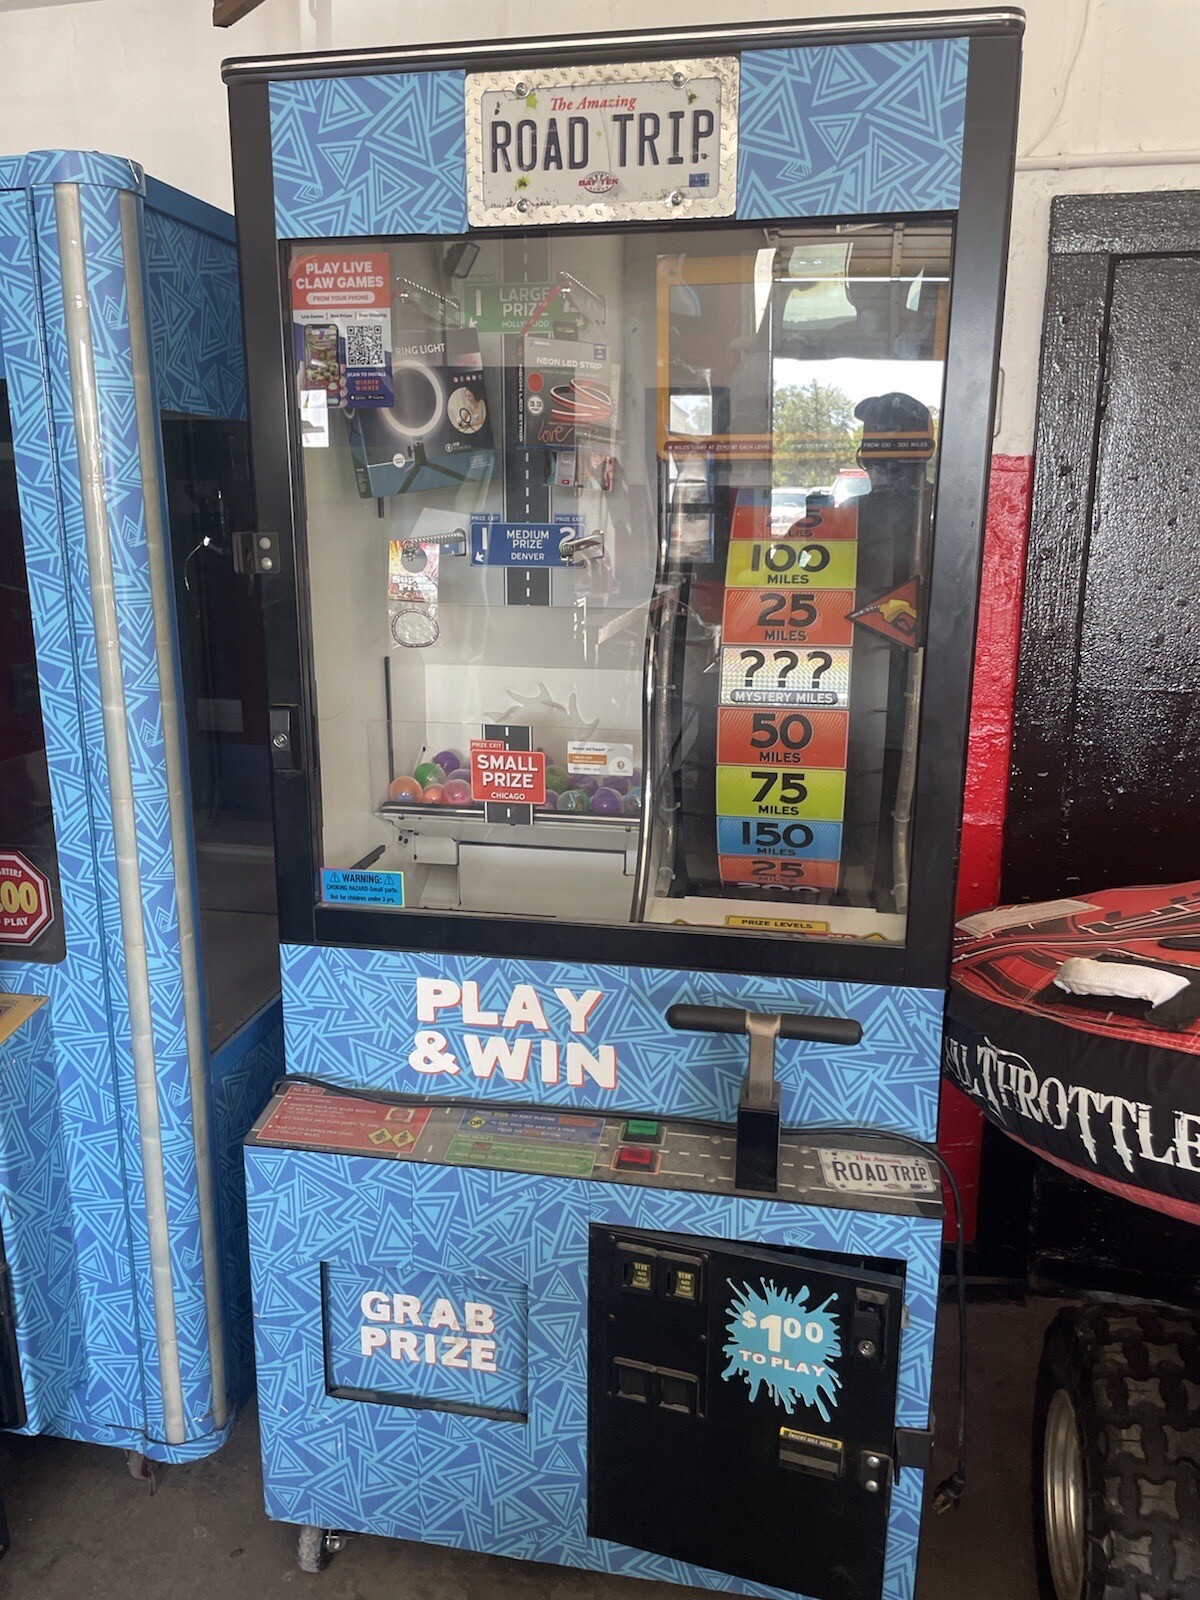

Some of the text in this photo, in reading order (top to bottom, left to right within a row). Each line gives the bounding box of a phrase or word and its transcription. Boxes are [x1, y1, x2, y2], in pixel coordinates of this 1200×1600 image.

[550, 95, 637, 111] The Amazing
[491, 110, 714, 173] ROAD TRIP
[578, 178, 619, 187] BAY TEK
[305, 261, 373, 275] PLAY LIVE
[296, 276, 384, 290] CLAW GAMES
[500, 287, 551, 301] LARGE
[502, 320, 550, 328] HOLLYOOD
[396, 343, 446, 356] RING LIGHT
[537, 357, 603, 370] NEON LED STRIP
[506, 530, 549, 540] MEDIUM
[512, 540, 543, 549] PRIZE
[511, 552, 545, 560] DENVER
[751, 544, 831, 572] 100
[767, 574, 809, 584] MILES
[757, 593, 818, 628] 25
[764, 630, 807, 641] MILES
[735, 691, 834, 704] MYSTERY MILES
[750, 713, 813, 750] 50
[476, 754, 538, 772] SMALL
[759, 752, 801, 763] MILES
[482, 772, 534, 789] PRIZE
[750, 771, 808, 804] 75
[490, 791, 526, 801] CHICAGO
[758, 805, 799, 816] MILES
[742, 821, 814, 848] 150
[757, 847, 796, 856] MILES
[750, 860, 805, 878] 25
[342, 873, 382, 884] WARNING:
[347, 894, 367, 902] children
[4, 917, 28, 927] PLAY
[741, 918, 813, 930] PRIZE LEVELS
[416, 977, 602, 1034] PLAY
[832, 1161, 928, 1181] ROAD TRIP
[361, 1290, 496, 1335] GRAB
[361, 1326, 497, 1373] PRIZE
[739, 1349, 826, 1377] TO PLAY
